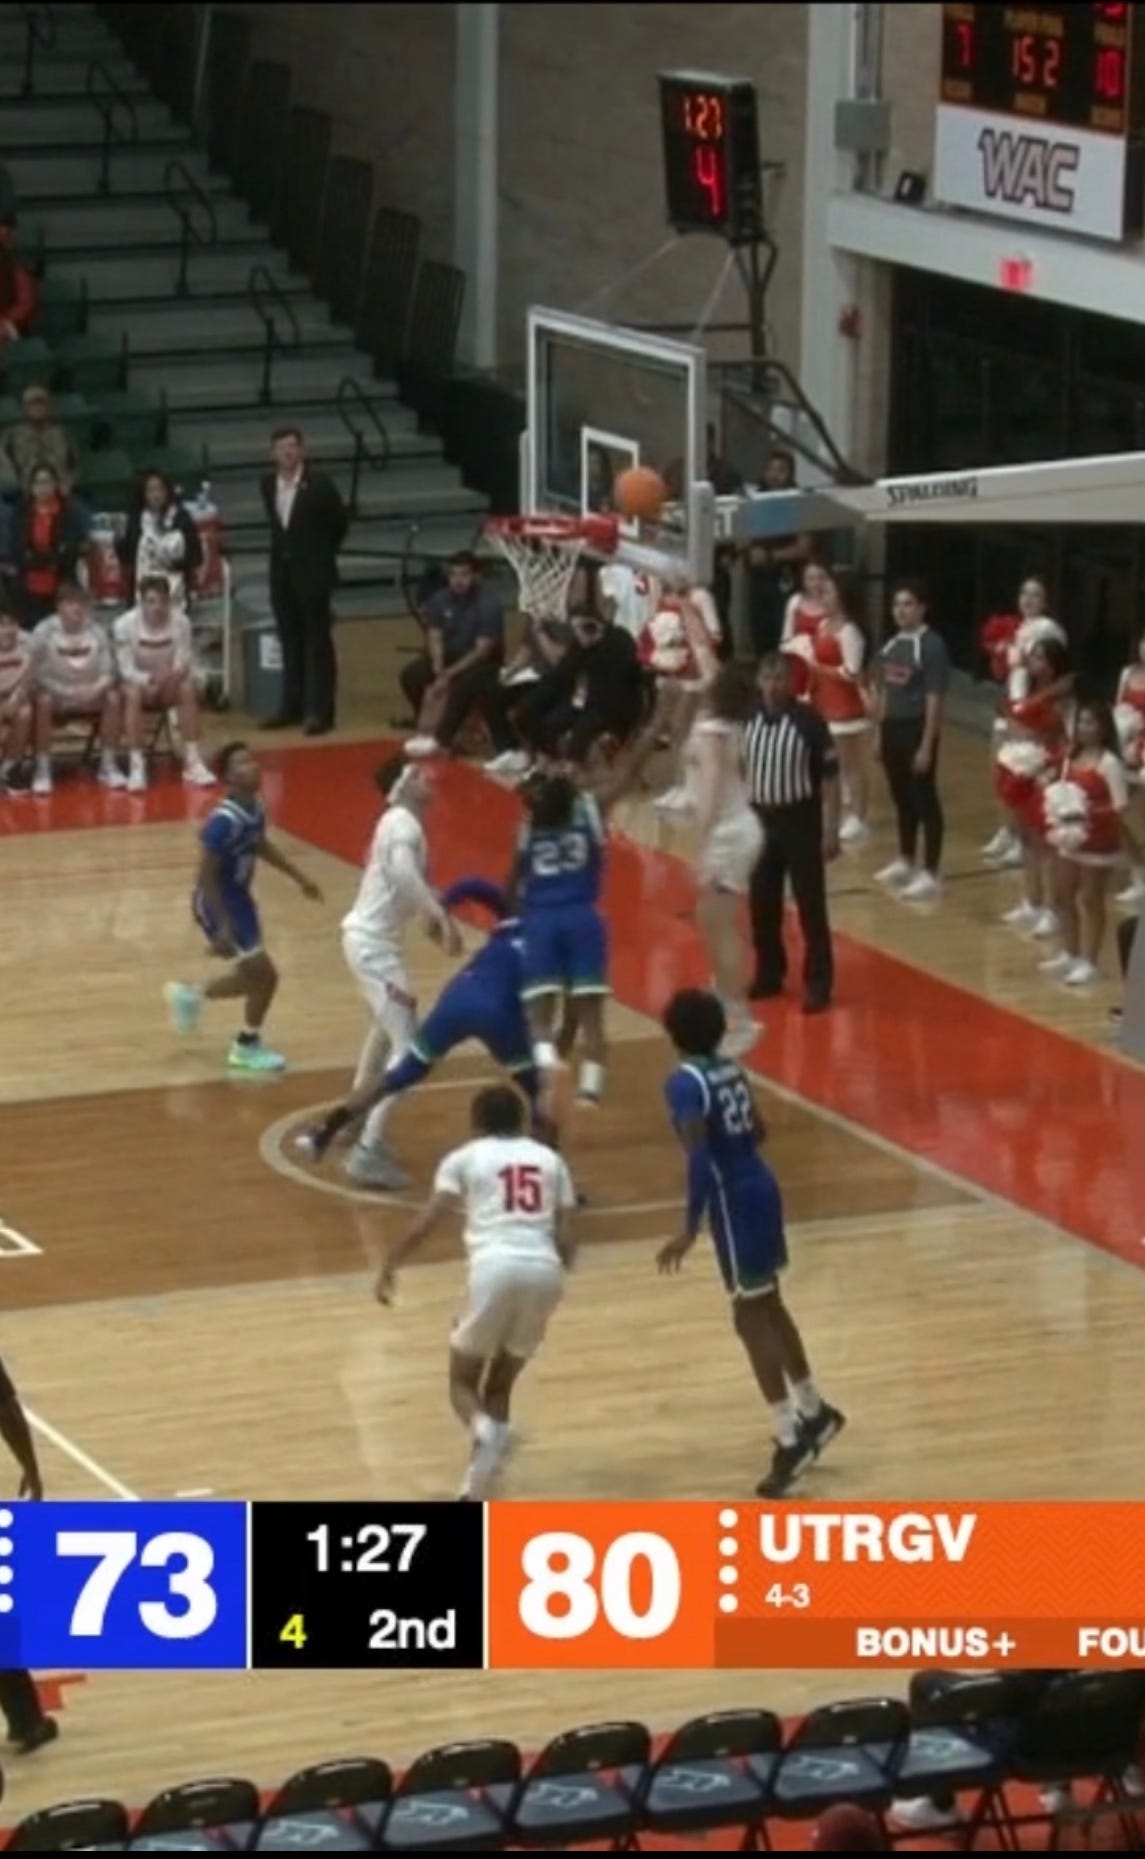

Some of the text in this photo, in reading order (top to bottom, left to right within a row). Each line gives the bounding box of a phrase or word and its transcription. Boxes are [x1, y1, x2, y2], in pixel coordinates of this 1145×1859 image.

[696, 146, 720, 216] 4
[978, 128, 1081, 215] WAC
[532, 832, 588, 876] 23
[717, 1081, 753, 1135] 22
[499, 1164, 543, 1214] 15
